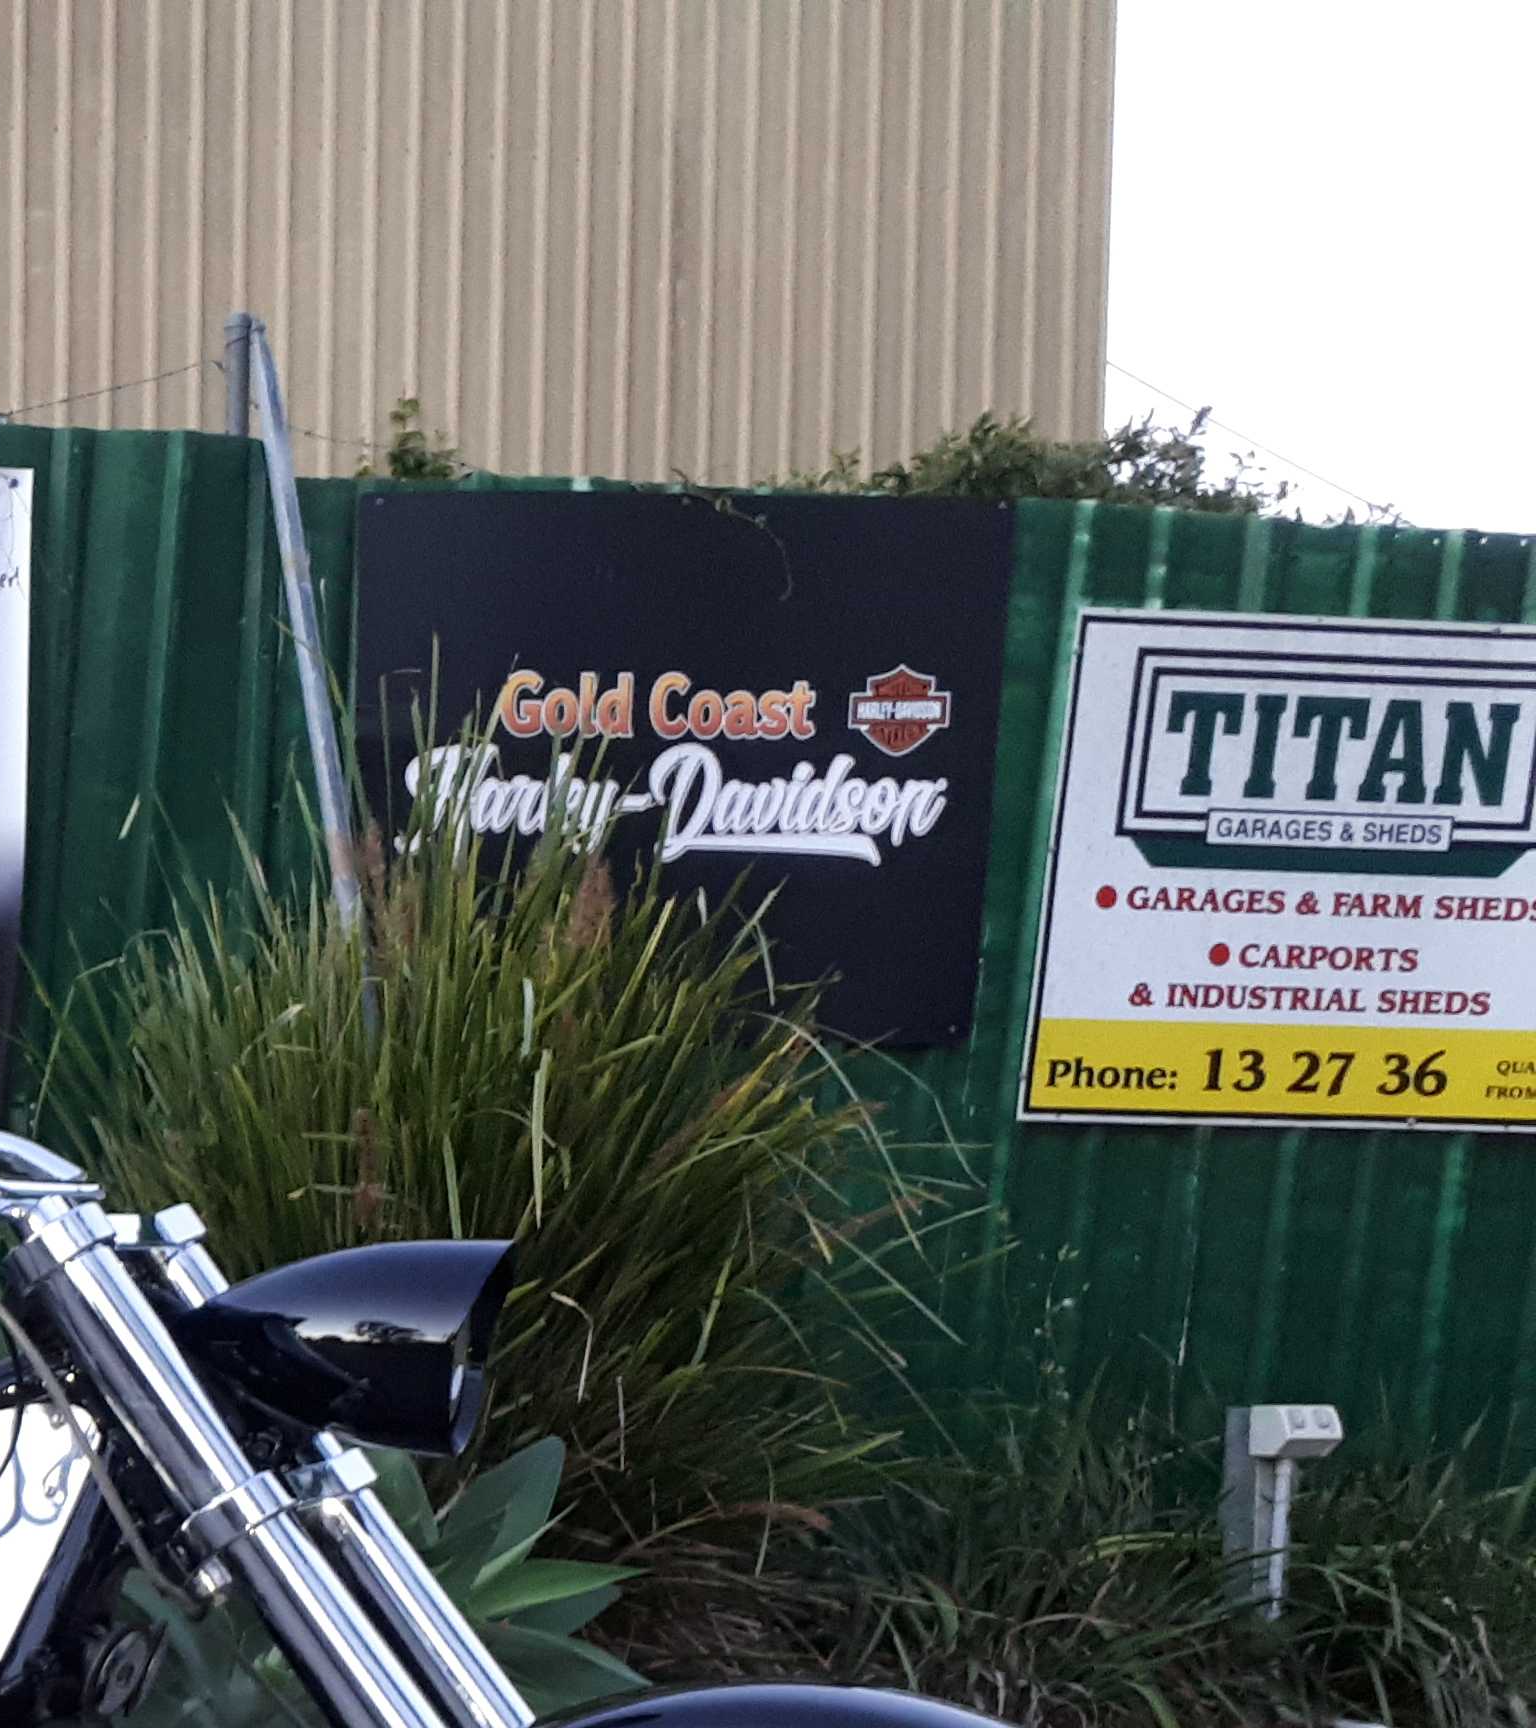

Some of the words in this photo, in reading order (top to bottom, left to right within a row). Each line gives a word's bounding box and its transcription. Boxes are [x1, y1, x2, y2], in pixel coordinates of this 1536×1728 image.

[500, 669, 634, 738] Gold
[649, 670, 817, 740] Coast
[1165, 690, 1522, 807] TITAN
[1215, 817, 1333, 843] GARAGES
[1339, 823, 1355, 842] &
[1361, 822, 1443, 846] SHEDS
[1127, 885, 1286, 915] GARAGES
[1295, 892, 1321, 916] &
[1331, 892, 1423, 920] FARM
[1239, 943, 1420, 973] CARPORTS
[1128, 983, 1154, 1007] &
[1167, 983, 1367, 1013] INDUSTRIAL
[1376, 990, 1492, 1016] SHEDS
[1046, 1057, 1179, 1091] Phone:
[1202, 1047, 1267, 1092] 13
[1286, 1050, 1357, 1097] 27
[1376, 1049, 1448, 1098] 36
